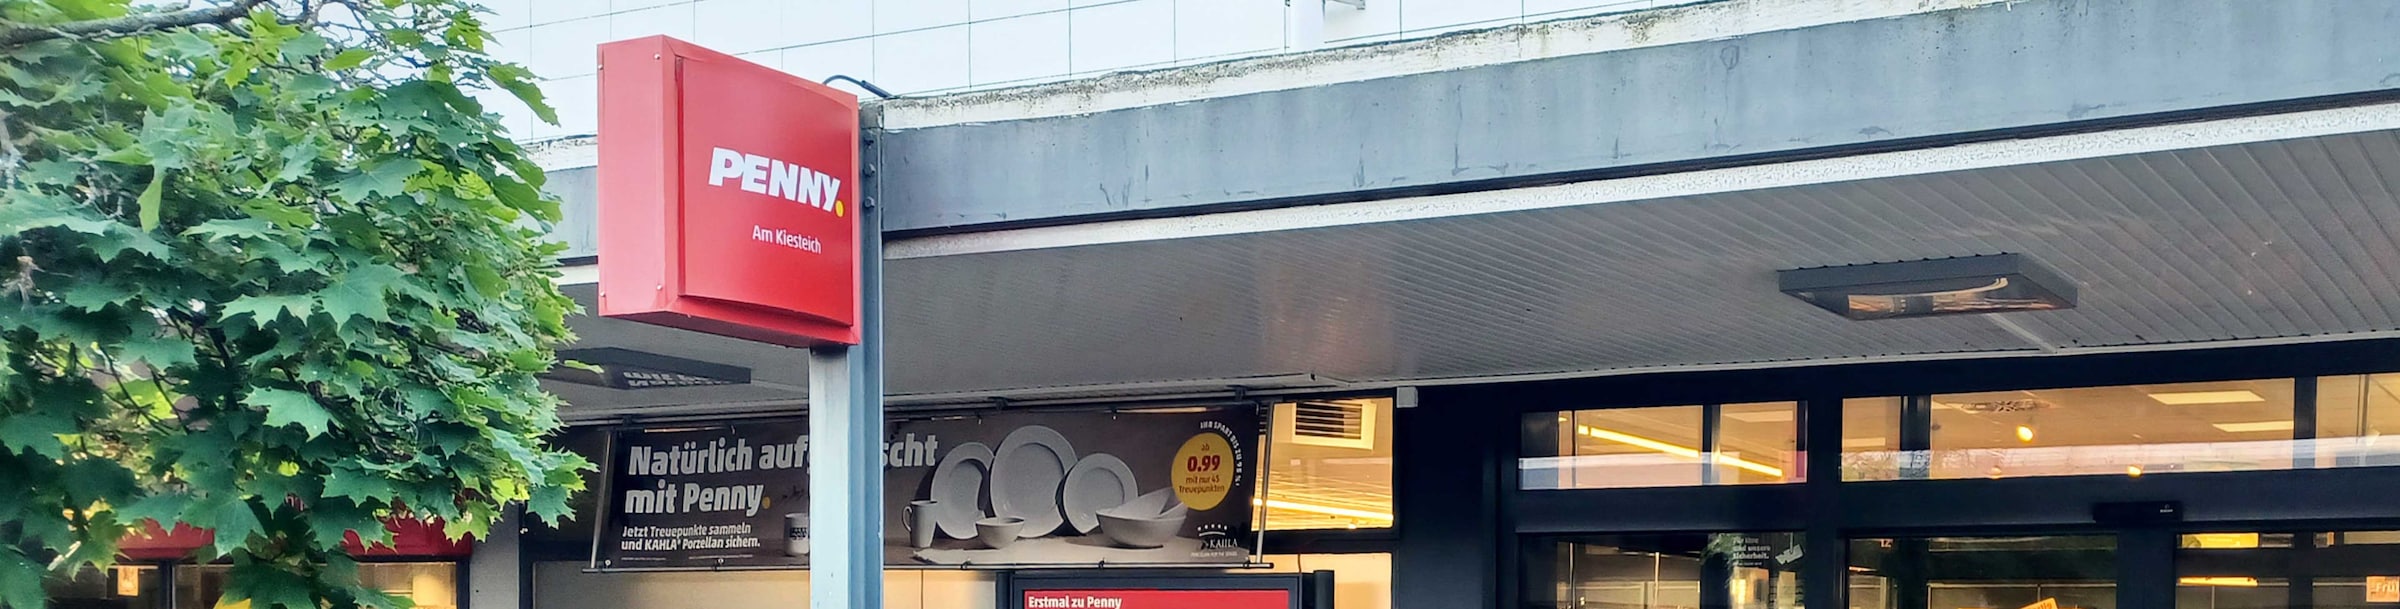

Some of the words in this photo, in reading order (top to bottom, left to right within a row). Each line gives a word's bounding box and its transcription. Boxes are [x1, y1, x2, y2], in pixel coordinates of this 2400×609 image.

[752, 225, 773, 243] Am
[775, 229, 822, 254] Kiesteich
[628, 436, 753, 476] Natürlich
[1187, 454, 1221, 472] 0.99
[1185, 476, 1198, 484] mit
[625, 479, 677, 514] mit
[1179, 484, 1225, 495] Treuepunkten
[622, 526, 649, 538] Jetzt
[650, 524, 707, 539] Treuepunkte
[708, 522, 751, 535] sammeln
[621, 538, 643, 550] und
[682, 536, 724, 550] Porzellan
[725, 535, 761, 548] sichern.
[1028, 595, 1070, 608] Erstmal
[1071, 598, 1084, 608] zu
[1087, 596, 1122, 609] Penny
